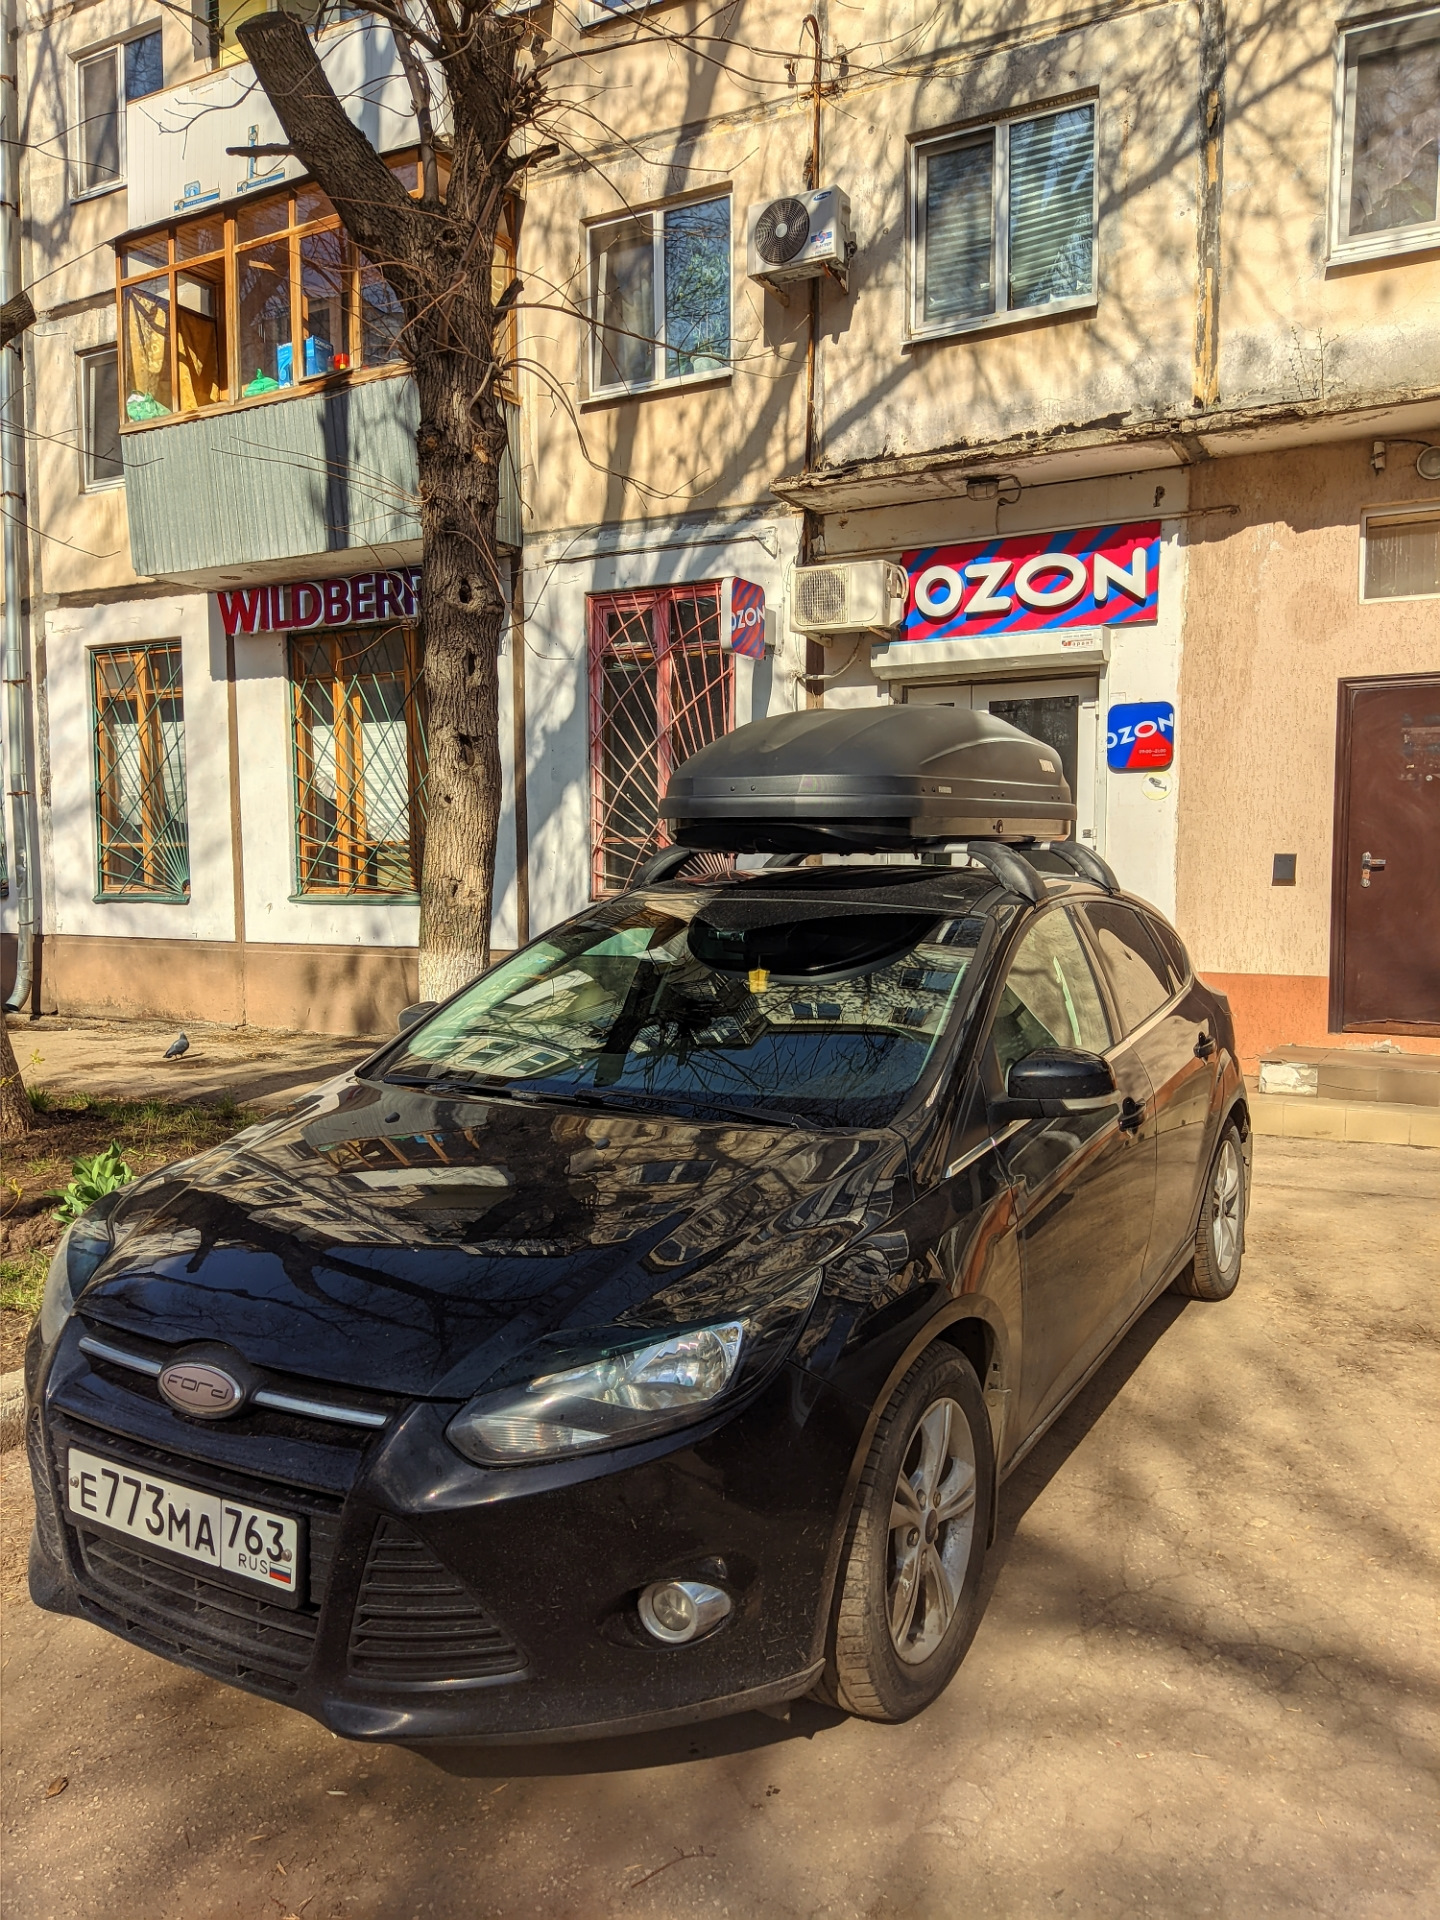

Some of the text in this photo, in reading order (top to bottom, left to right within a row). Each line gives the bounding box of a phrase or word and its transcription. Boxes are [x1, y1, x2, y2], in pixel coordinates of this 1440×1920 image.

[915, 547, 1147, 618] OZON
[225, 1507, 284, 1562] 763
[238, 1553, 268, 1575] RUS
